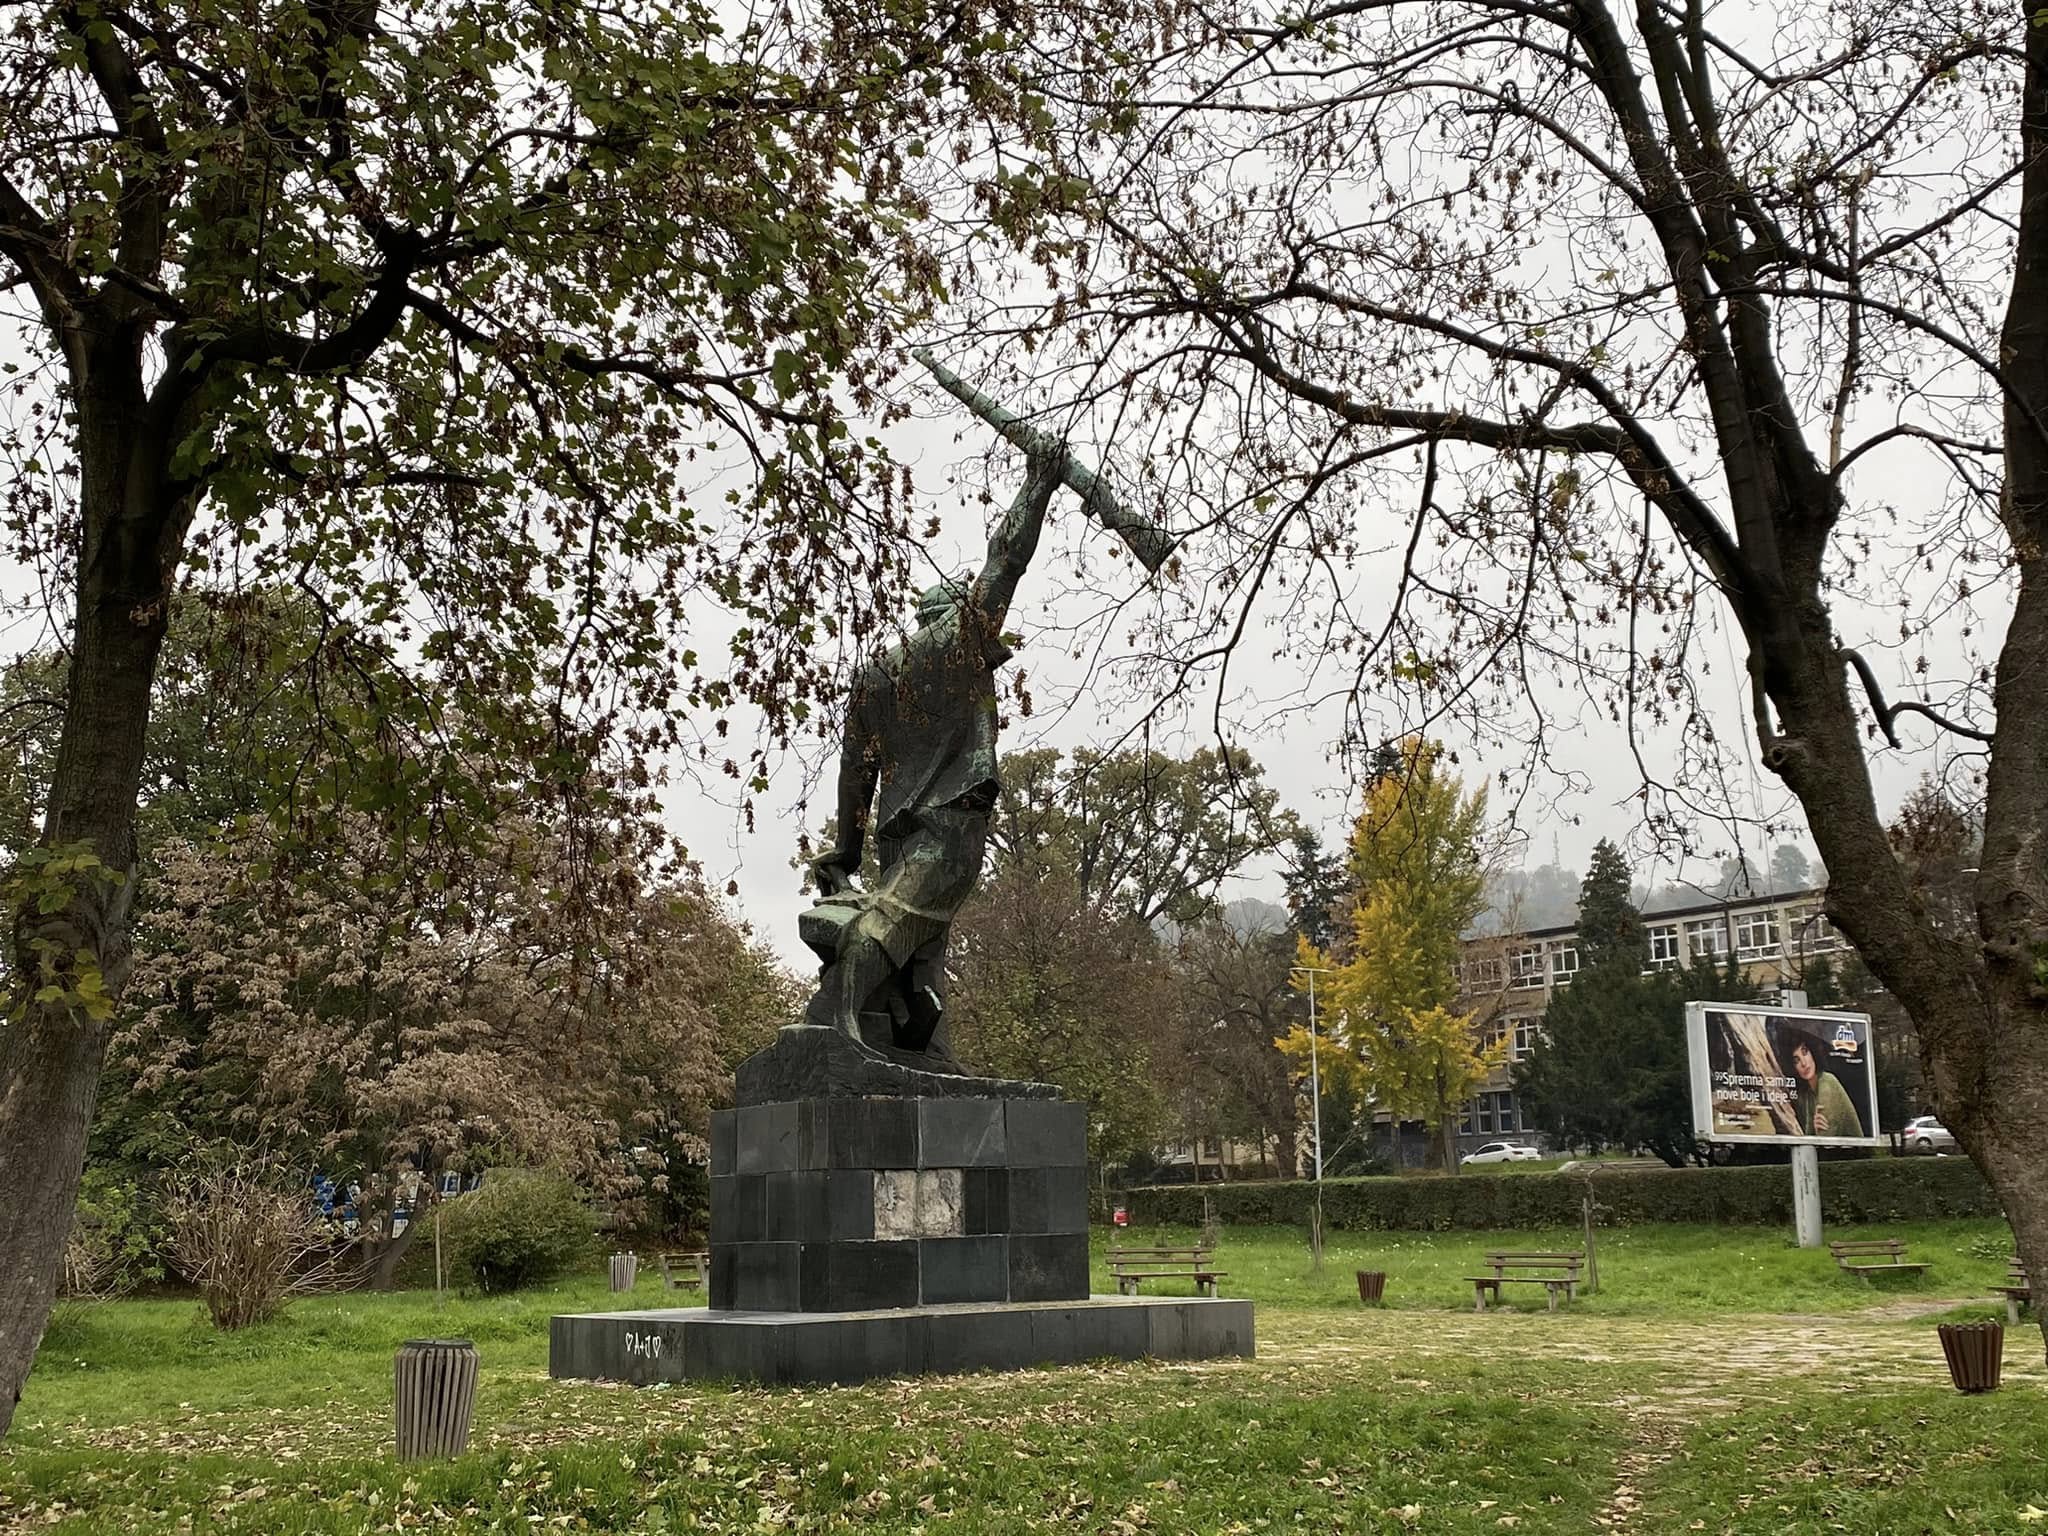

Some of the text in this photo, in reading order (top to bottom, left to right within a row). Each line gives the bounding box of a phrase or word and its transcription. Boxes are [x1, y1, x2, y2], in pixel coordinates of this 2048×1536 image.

[1765, 1077, 1784, 1087] sam
[1785, 1077, 1796, 1088] za
[1717, 1089, 1739, 1101] nove
[1740, 1088, 1760, 1104] boje
